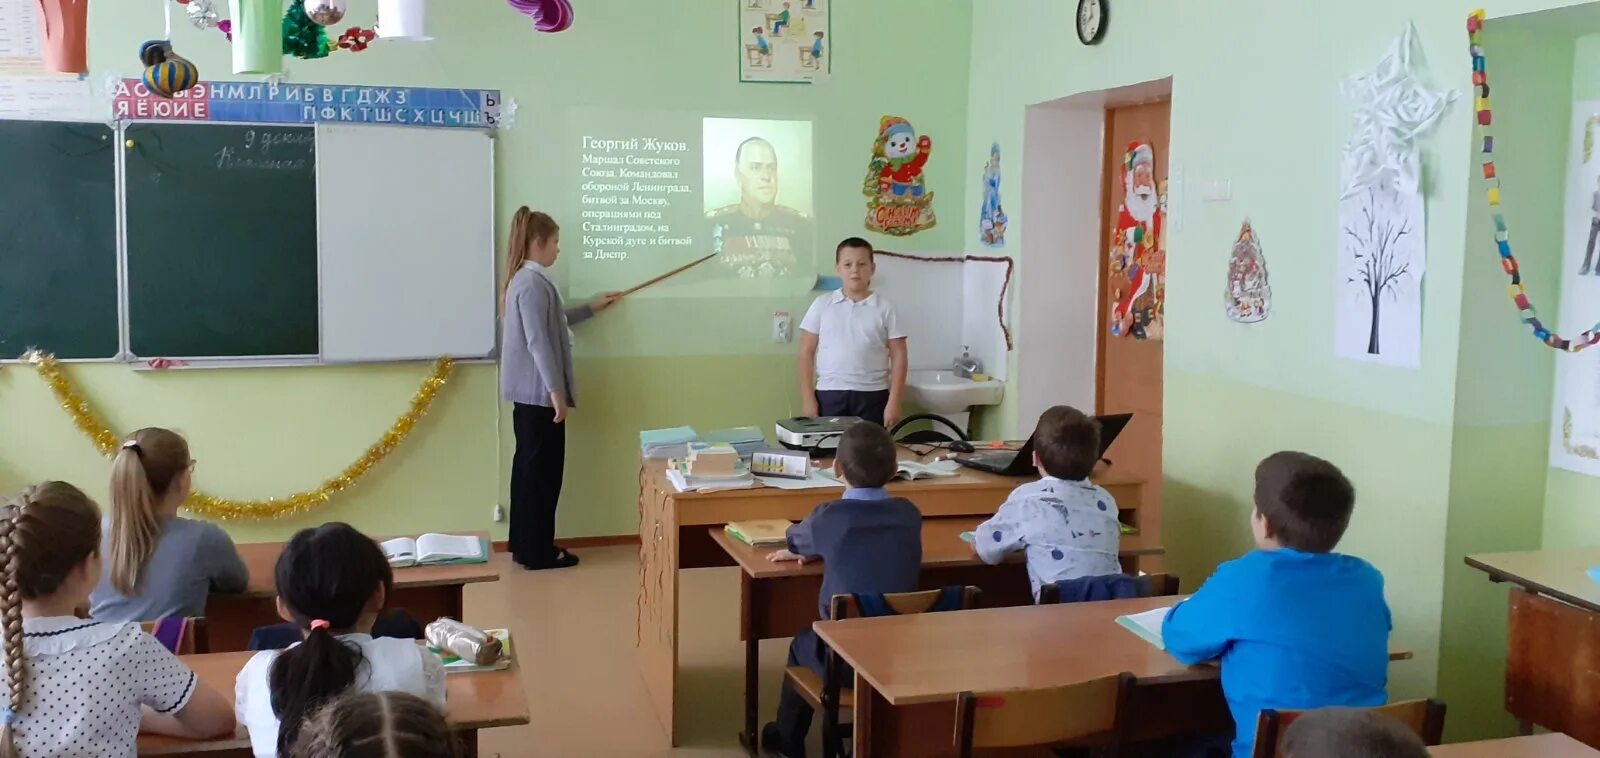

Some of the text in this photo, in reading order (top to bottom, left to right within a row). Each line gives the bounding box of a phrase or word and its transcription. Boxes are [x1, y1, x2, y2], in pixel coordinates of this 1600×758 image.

[245, 130, 256, 148] 9
[582, 135, 690, 153] Георгий Жуков.
[582, 154, 681, 166] Маршал Советского
[582, 167, 679, 179] Союза. Командовал
[581, 181, 629, 192] обороной
[582, 194, 670, 207] битвой за Москву,
[582, 210, 661, 220] операциями под
[582, 222, 656, 233] Сталинградом,
[583, 235, 623, 247] Курской
[625, 238, 647, 247] дуге
[658, 237, 692, 246] битвой
[595, 250, 629, 261] Днепр.
